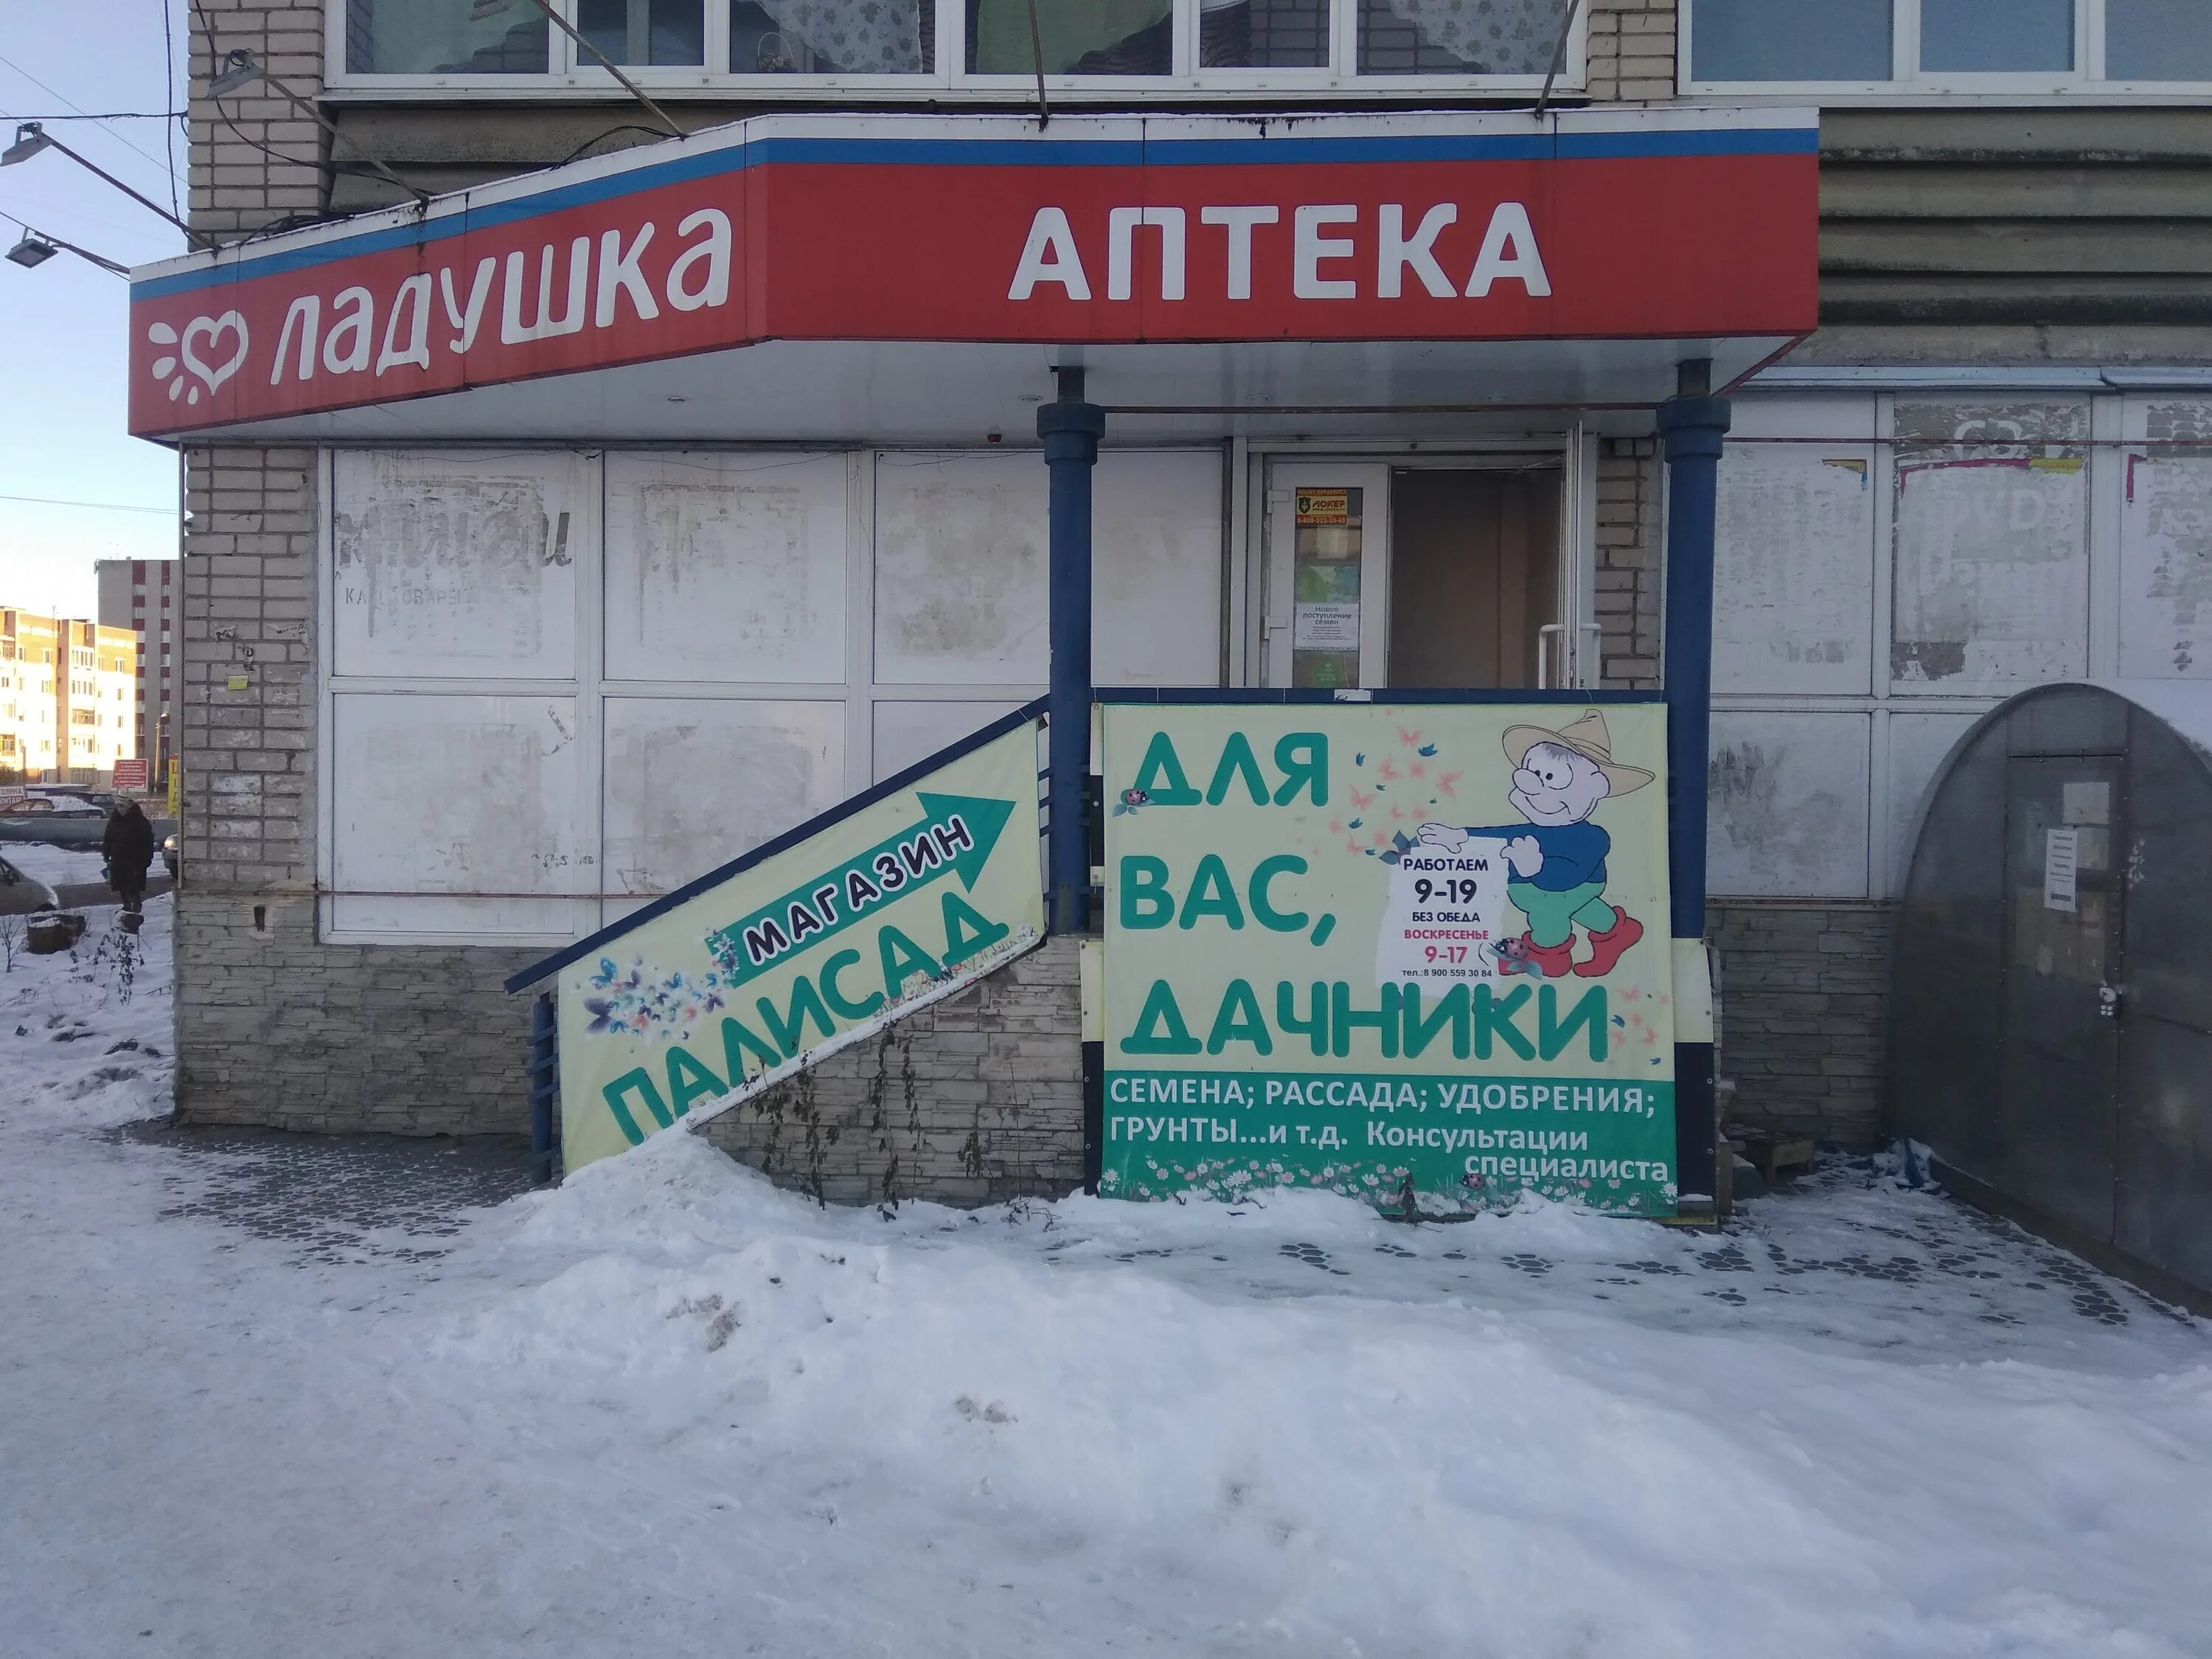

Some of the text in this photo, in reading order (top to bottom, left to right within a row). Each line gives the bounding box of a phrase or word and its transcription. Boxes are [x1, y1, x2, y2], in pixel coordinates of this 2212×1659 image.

[1007, 201, 1552, 300] АПТЕКА
[1312, 500, 1345, 508] ЛОКЕР
[1121, 731, 1328, 807] ДЛЯ
[1403, 858, 1489, 872] РАБОТАЕМ
[743, 813, 975, 966] МАГАЗИН
[1119, 854, 1336, 947] ВАС,
[1414, 878, 1478, 904] 9-19
[1412, 911, 1481, 922] БЕЗ ОБЕДА
[1404, 929, 1489, 940] ВОСКРЕСЕНЬЕ
[1425, 945, 1468, 964] 9-17
[1431, 969, 1447, 977] 900
[1450, 969, 1466, 978] 559
[1468, 969, 1479, 978] 30
[1481, 969, 1492, 978] 84
[602, 891, 1009, 1147] ПАЛИСАД
[1120, 979, 1608, 1062] ДАЧНИКИ
[1110, 1078, 1656, 1119] СЕМЕНА; РАССАДА; УДОБРЕНИЯ;
[1367, 1121, 1588, 1155] Консультации
[1465, 1155, 1668, 1182] специалиста
